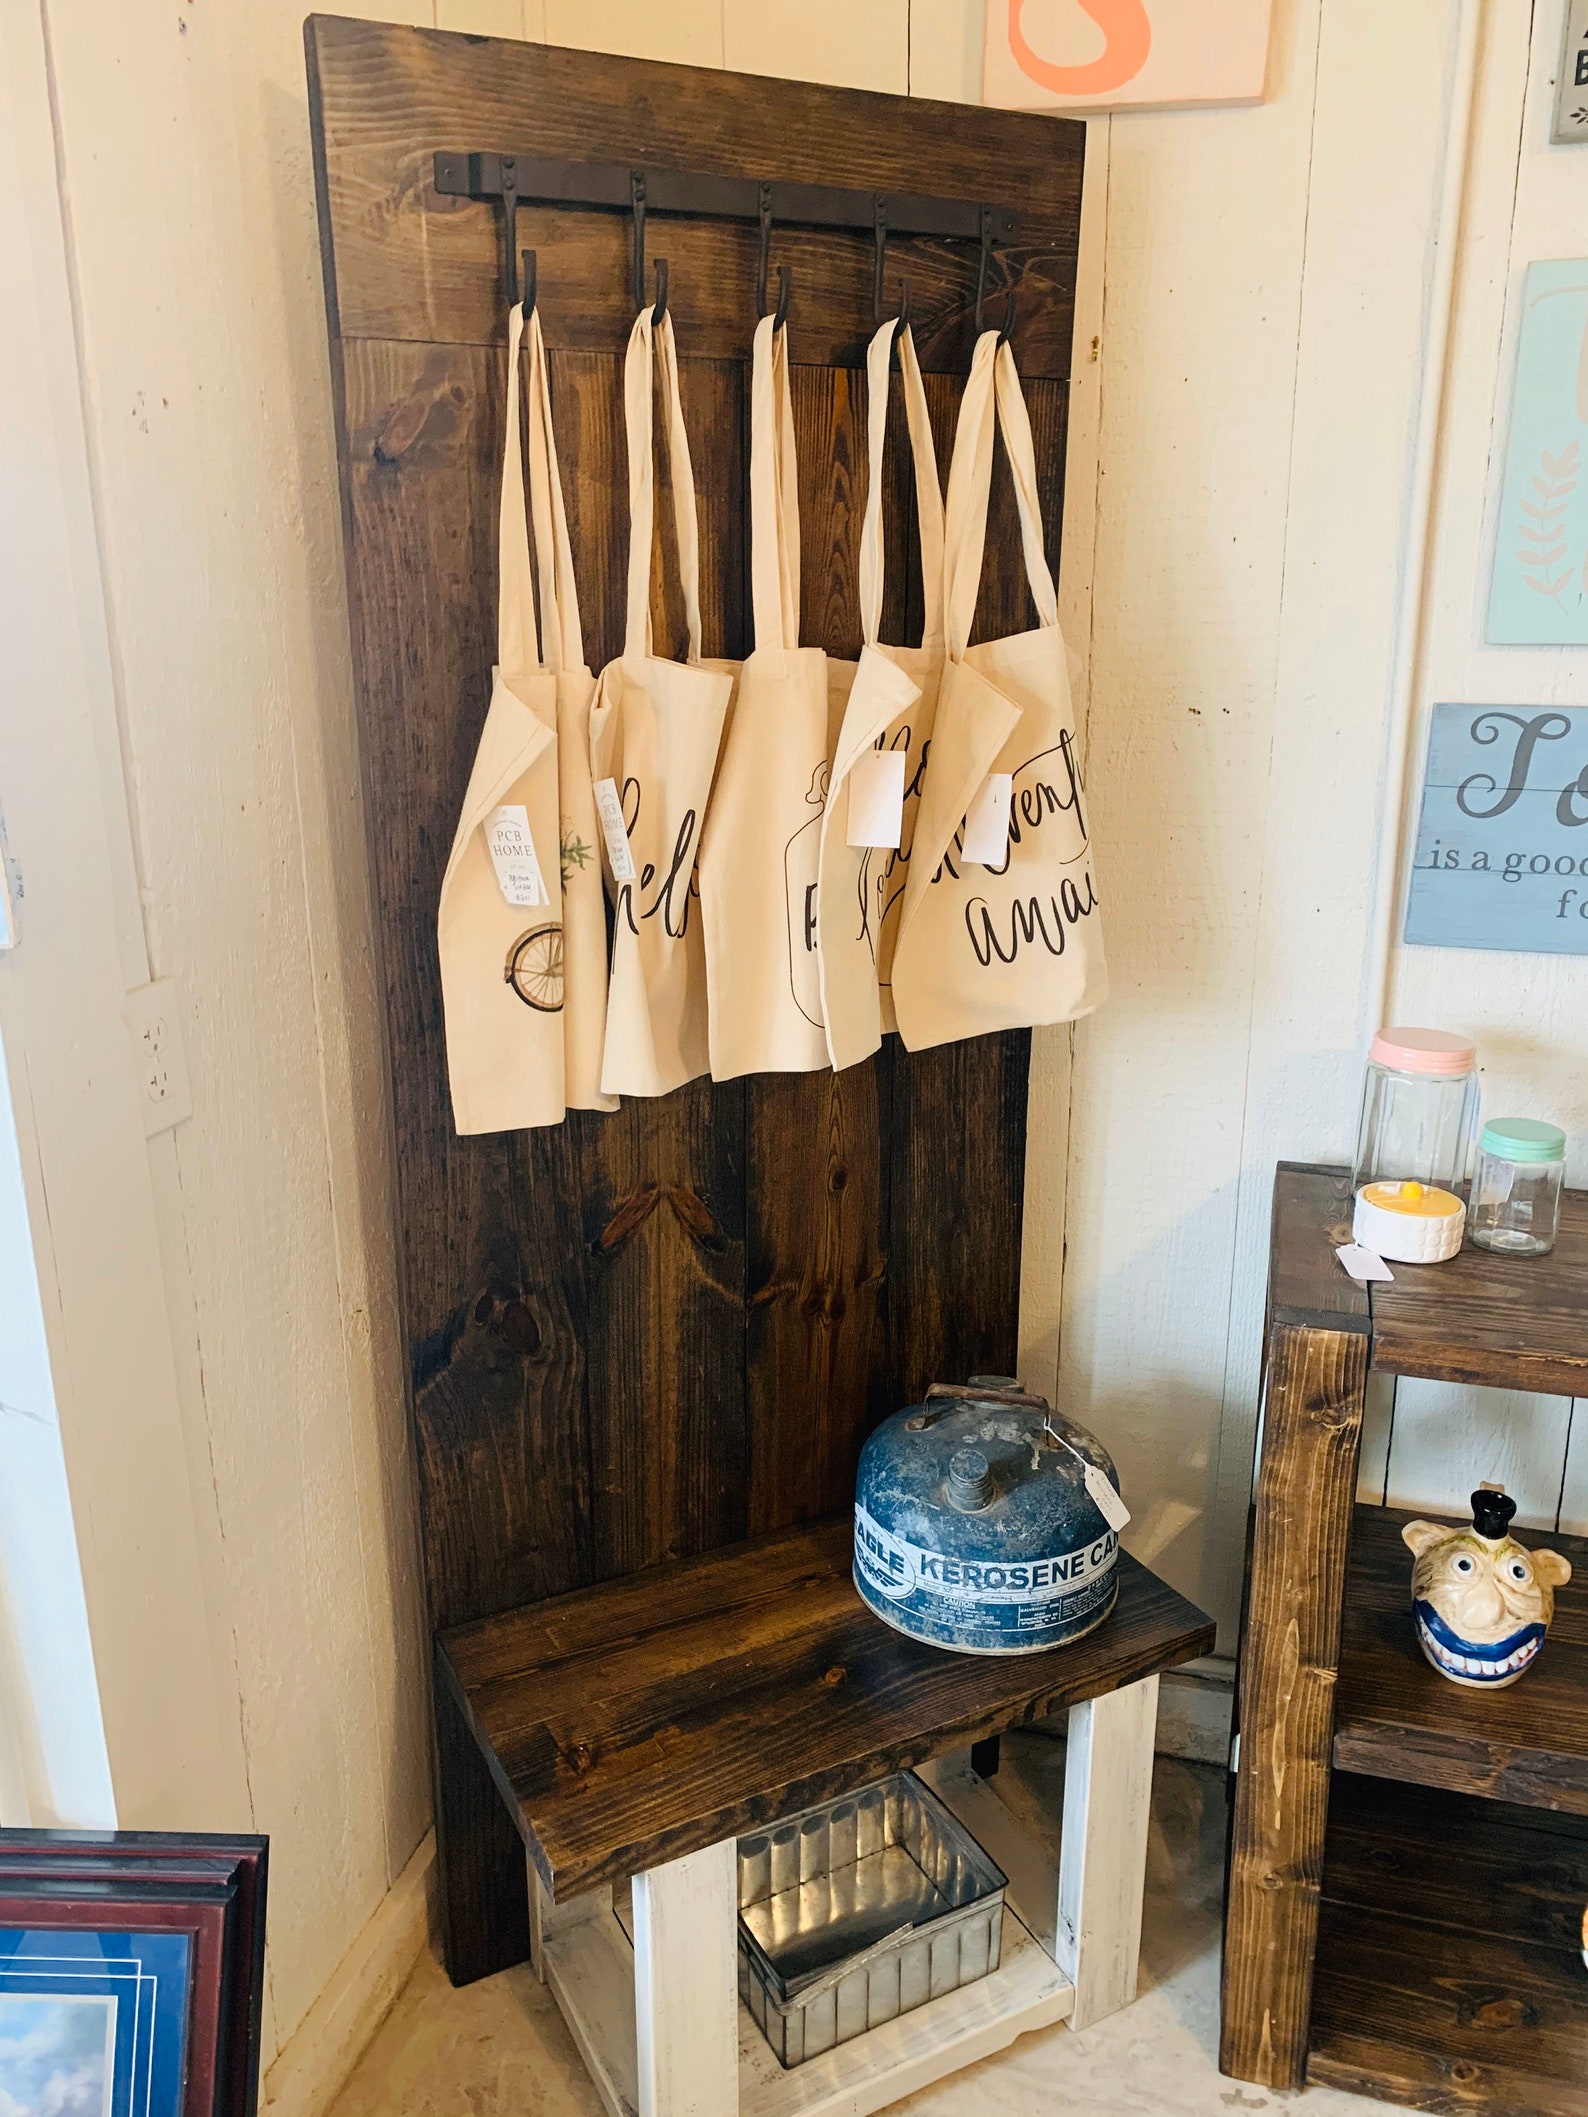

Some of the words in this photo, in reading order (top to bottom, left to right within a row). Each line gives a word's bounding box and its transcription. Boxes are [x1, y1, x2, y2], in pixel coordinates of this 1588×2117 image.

[496, 830, 522, 842] PCB
[493, 845, 533, 857] HOME
[1429, 839, 1460, 870] is
[1471, 850, 1492, 871] a
[920, 1551, 1085, 1591] KEROSENE
[943, 1596, 976, 1610] CAUTION
